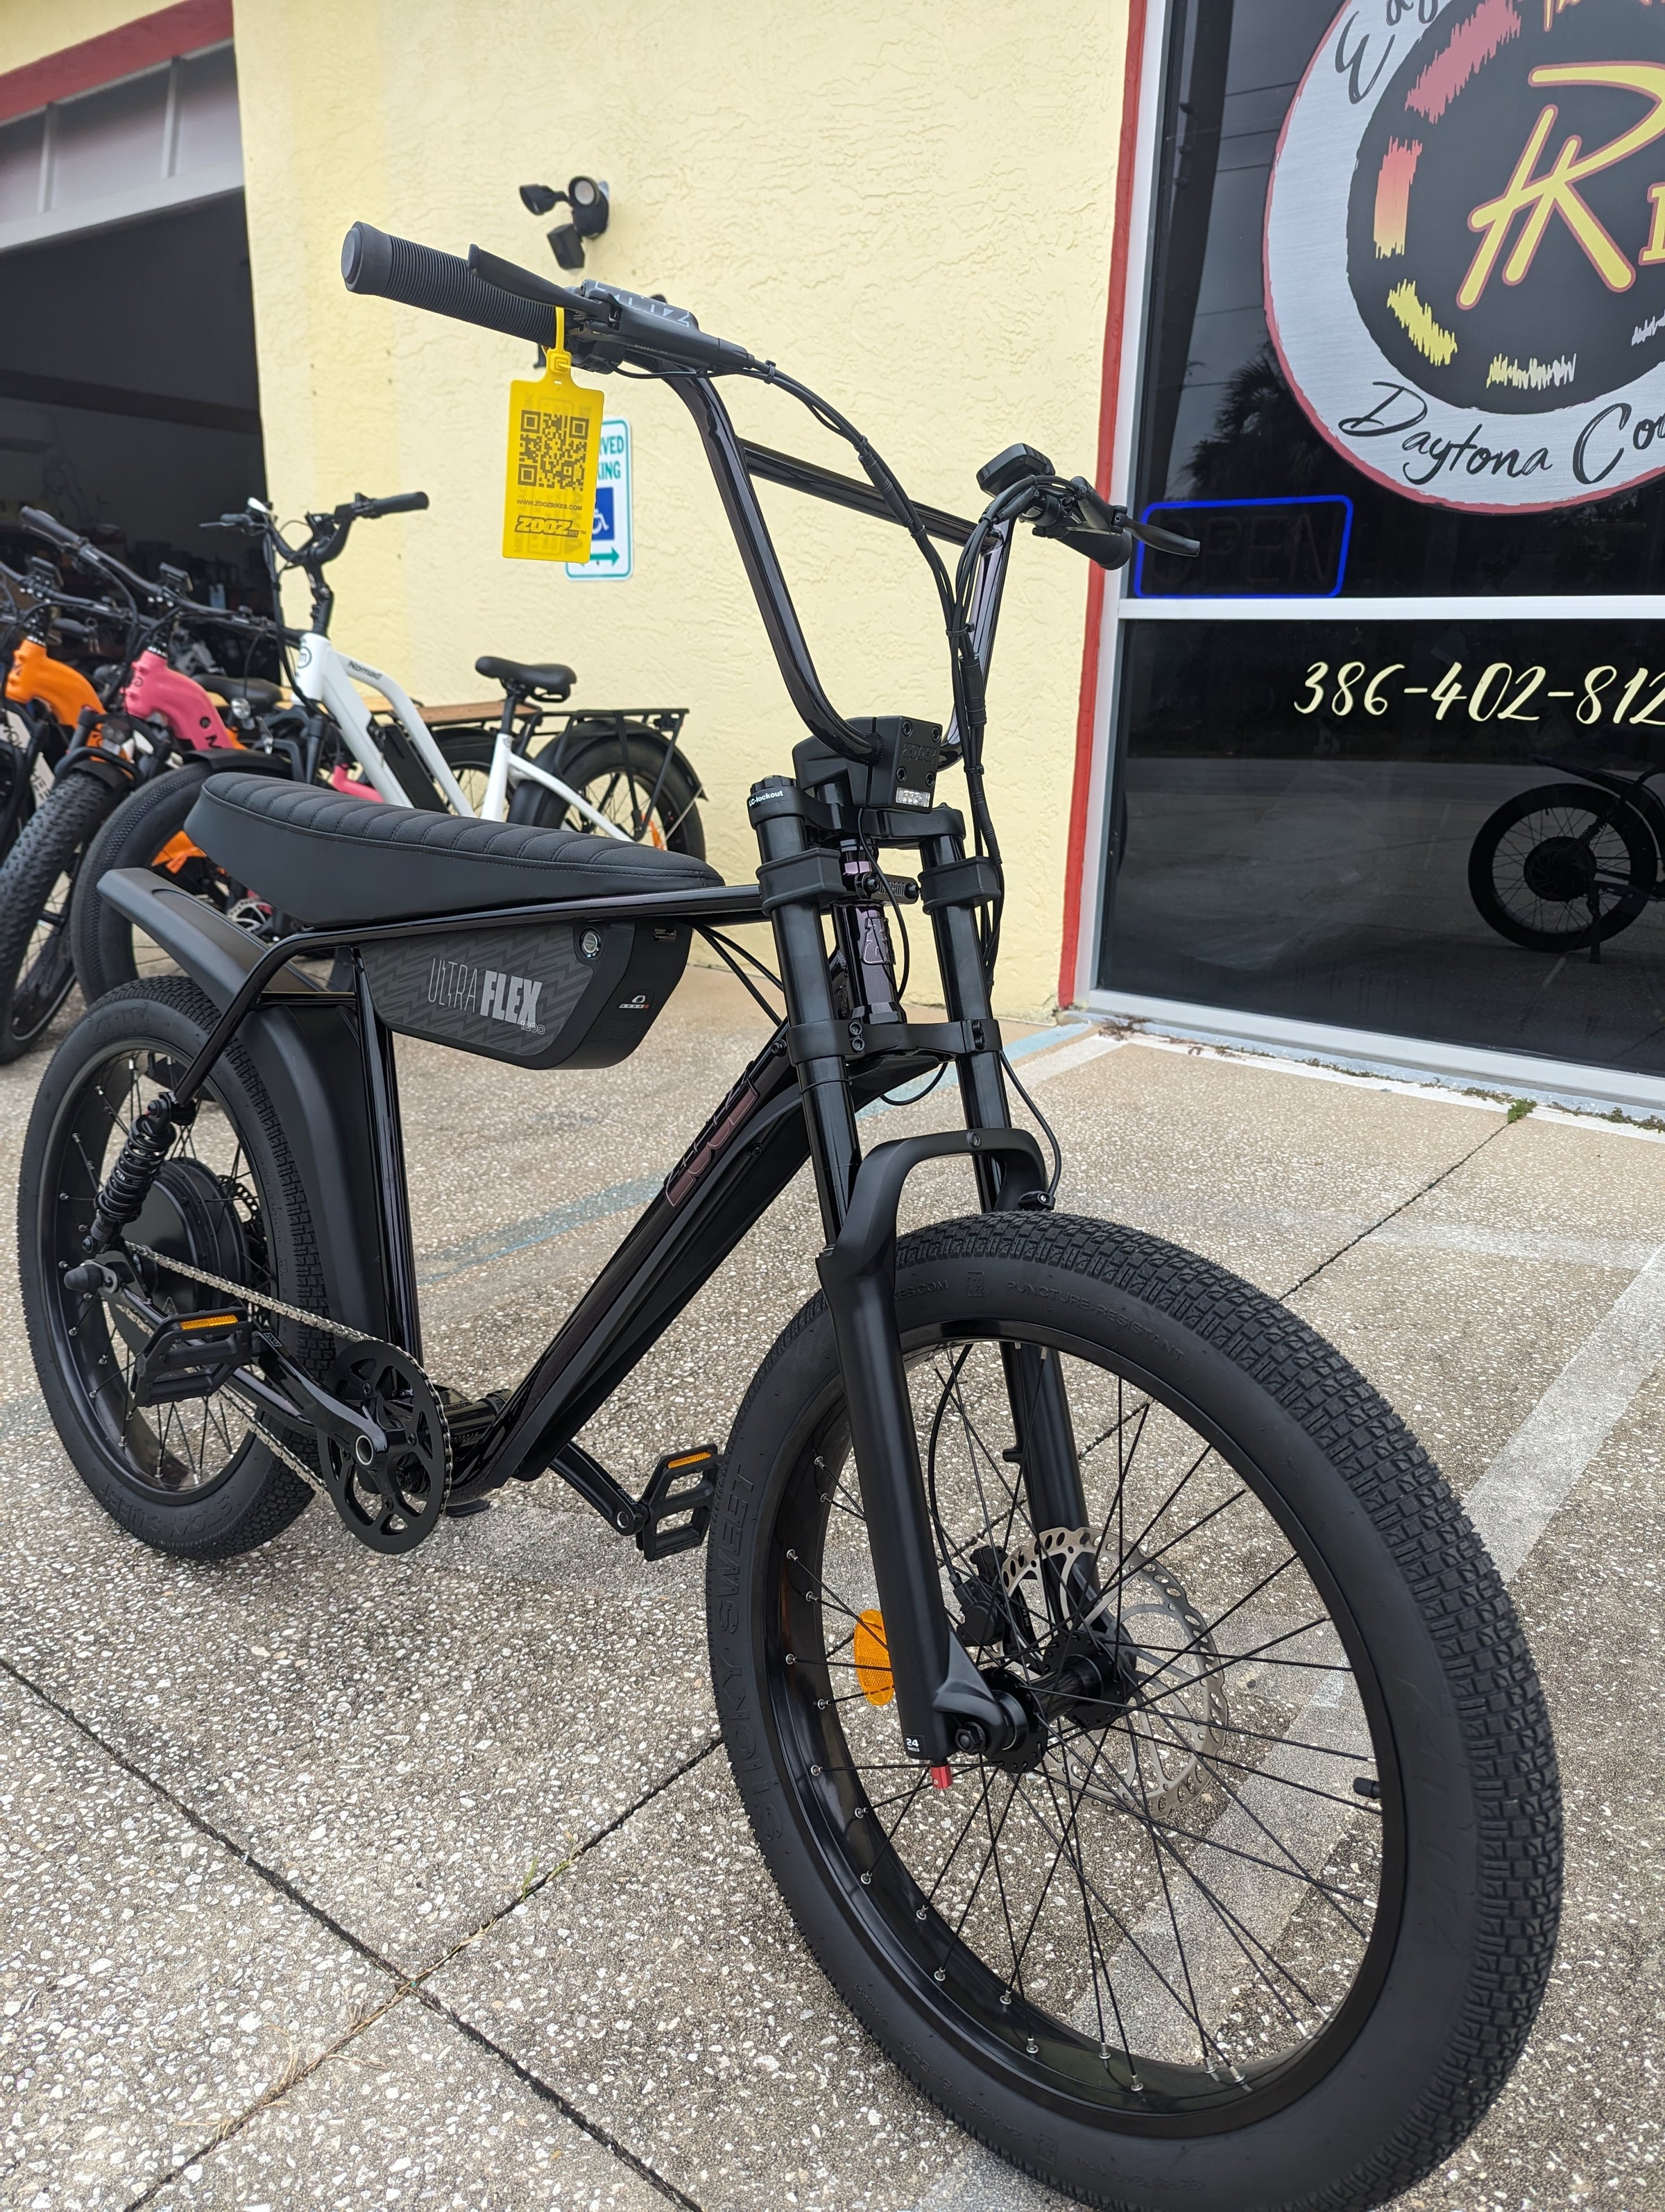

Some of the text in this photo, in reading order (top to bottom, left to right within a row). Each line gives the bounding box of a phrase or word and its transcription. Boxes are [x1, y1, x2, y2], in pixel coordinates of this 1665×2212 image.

[1338, 381, 1553, 486] Daytona
[516, 499, 583, 511] WWW.ZOOZBIKES.COM
[514, 515, 574, 537] ZOOZ
[346, 660, 384, 681] Nomad
[427, 957, 543, 1026] ULTRA FLEX
[718, 1462, 755, 1635] SWEET
[905, 1737, 920, 1748] 24
